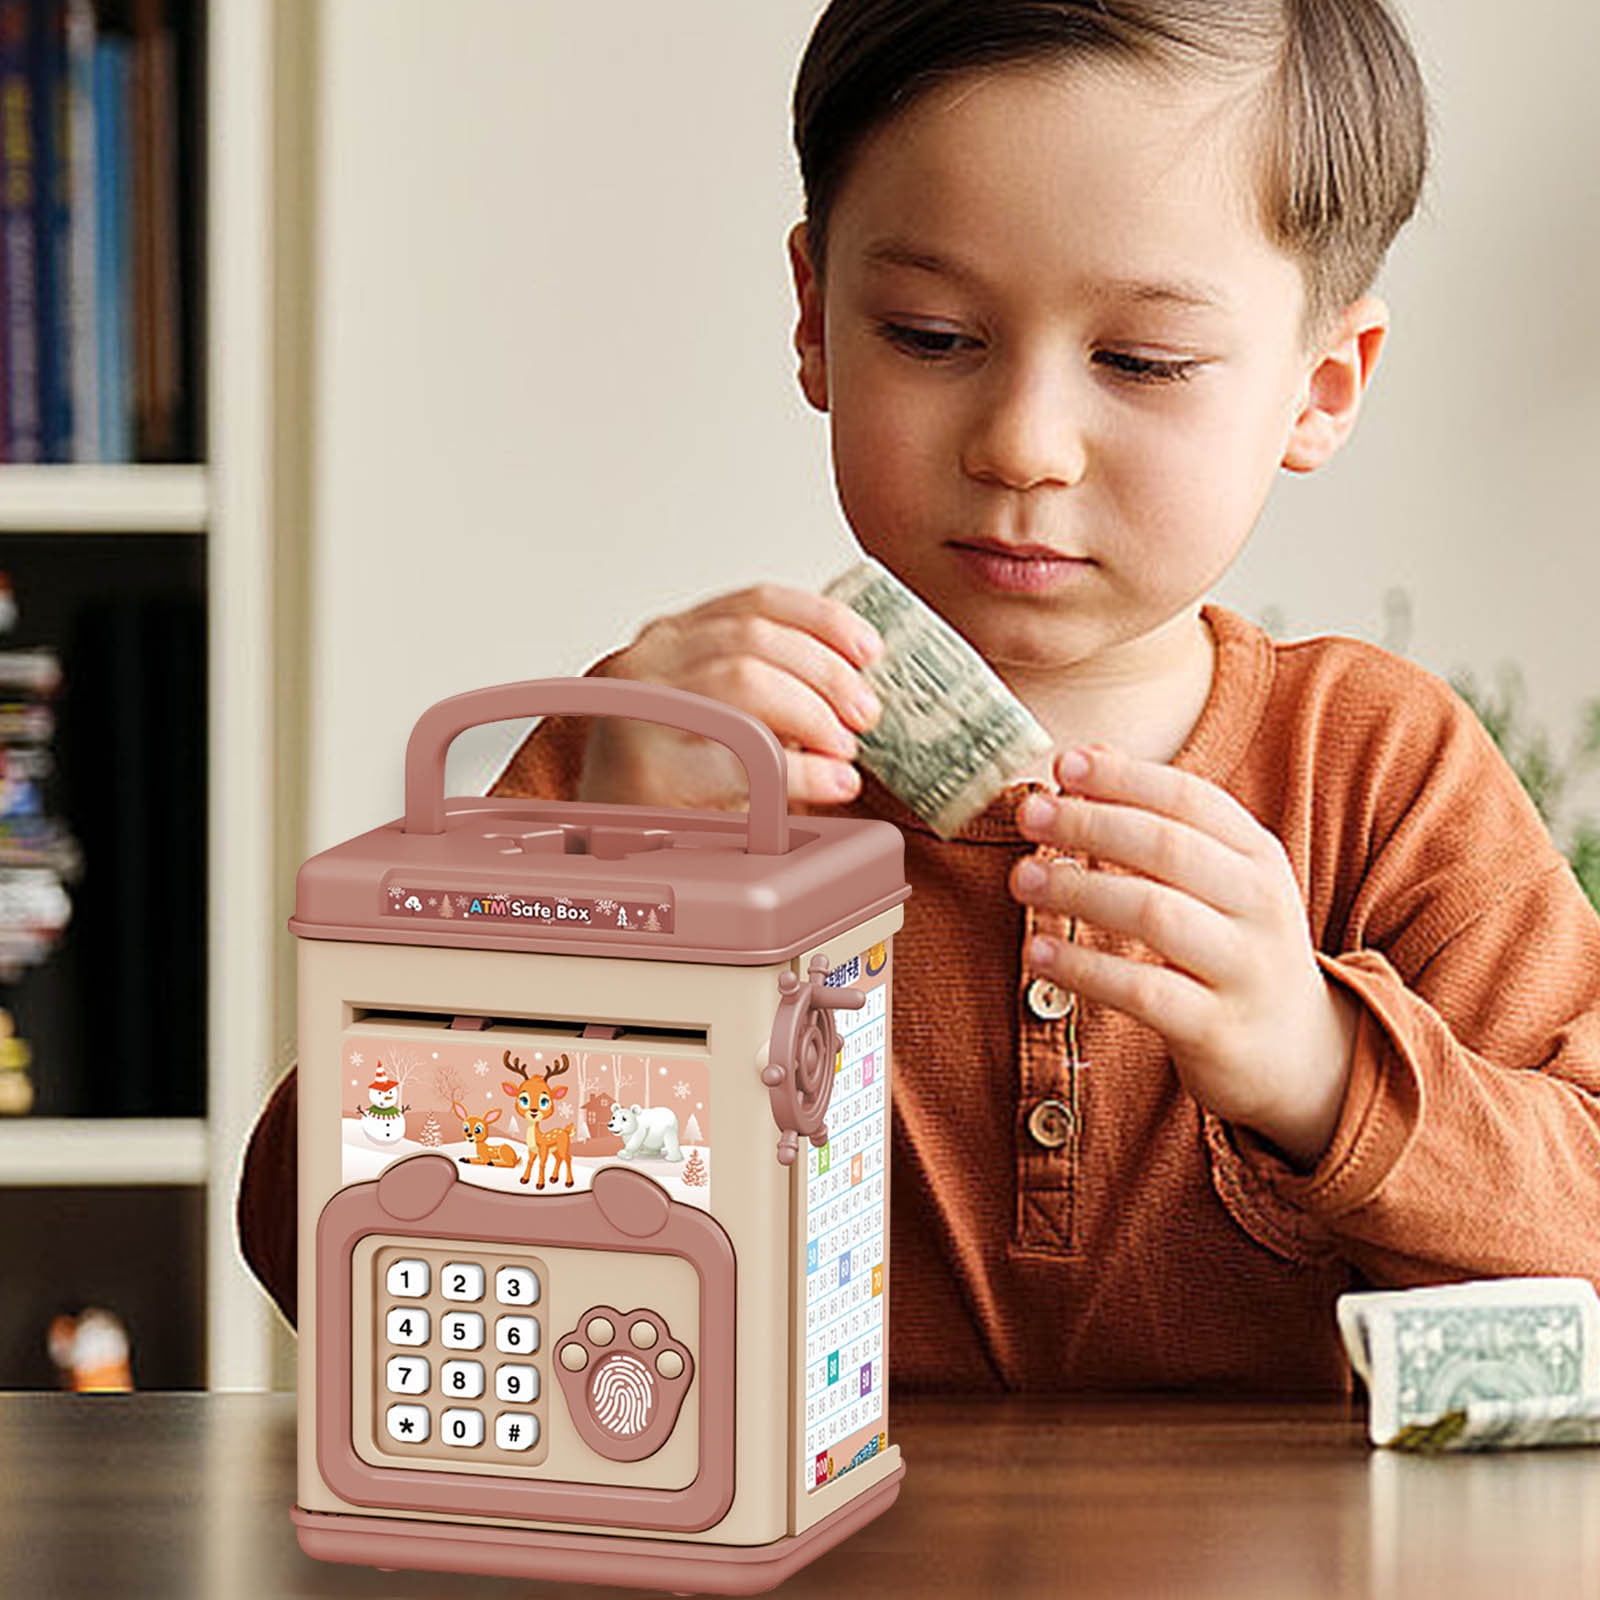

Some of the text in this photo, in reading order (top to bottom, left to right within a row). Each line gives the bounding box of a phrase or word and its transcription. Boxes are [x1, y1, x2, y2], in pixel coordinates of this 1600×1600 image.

[470, 899, 589, 920] ATM Safe Box
[401, 1271, 520, 1296] 1 2 3
[399, 1319, 520, 1345] 4 5 6
[399, 1367, 520, 1394] 7 8 9
[453, 1420, 465, 1438] 0
[509, 1424, 520, 1442] #
[817, 1458, 827, 1477] 100
